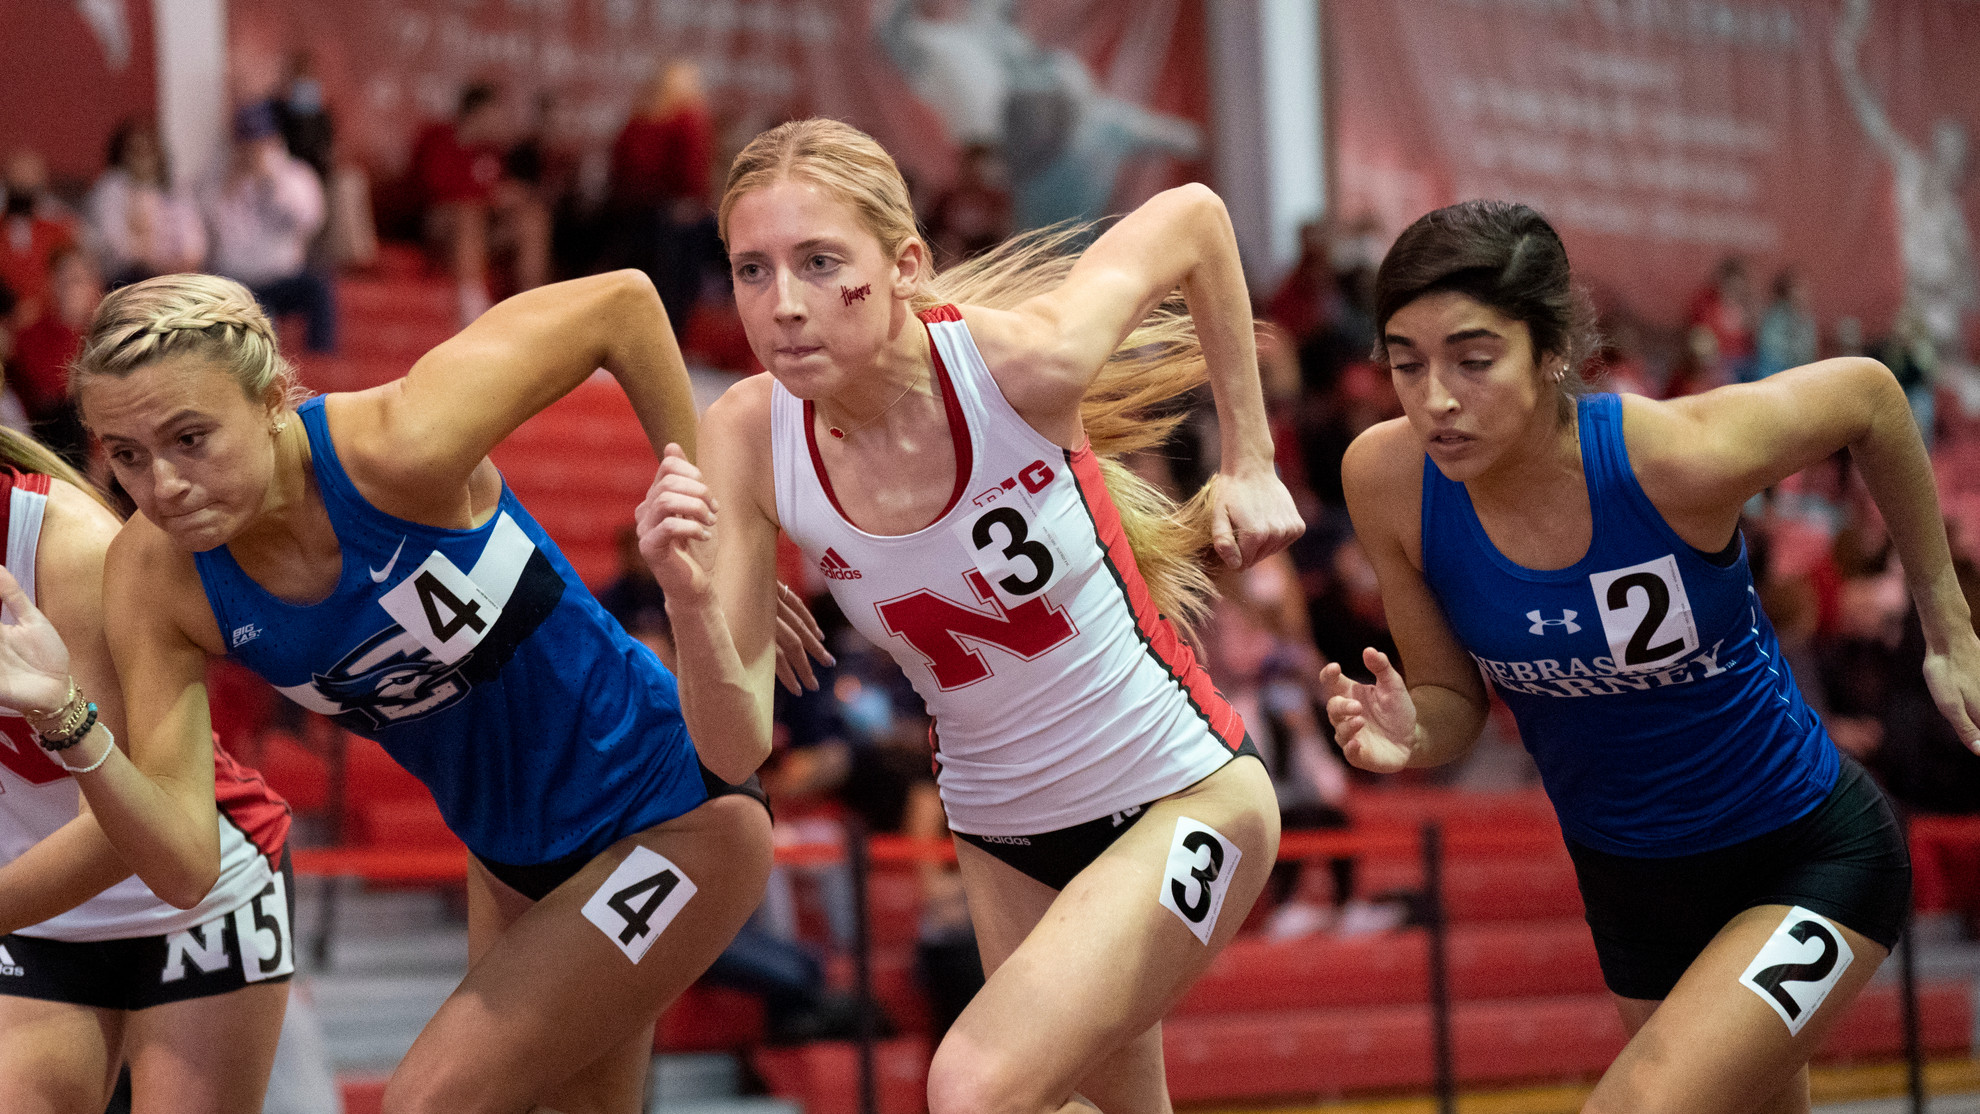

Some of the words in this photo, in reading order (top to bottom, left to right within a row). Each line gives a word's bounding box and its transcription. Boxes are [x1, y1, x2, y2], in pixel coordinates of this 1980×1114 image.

[972, 507, 1054, 595] 3
[233, 623, 255, 639] BIG
[414, 570, 488, 644] 4
[873, 567, 1080, 692] N
[1606, 572, 1686, 666] 2
[607, 869, 681, 947] 4
[1171, 831, 1224, 923] 3
[161, 914, 230, 982] N
[251, 882, 283, 974] 5
[1751, 920, 1839, 1022] 2
